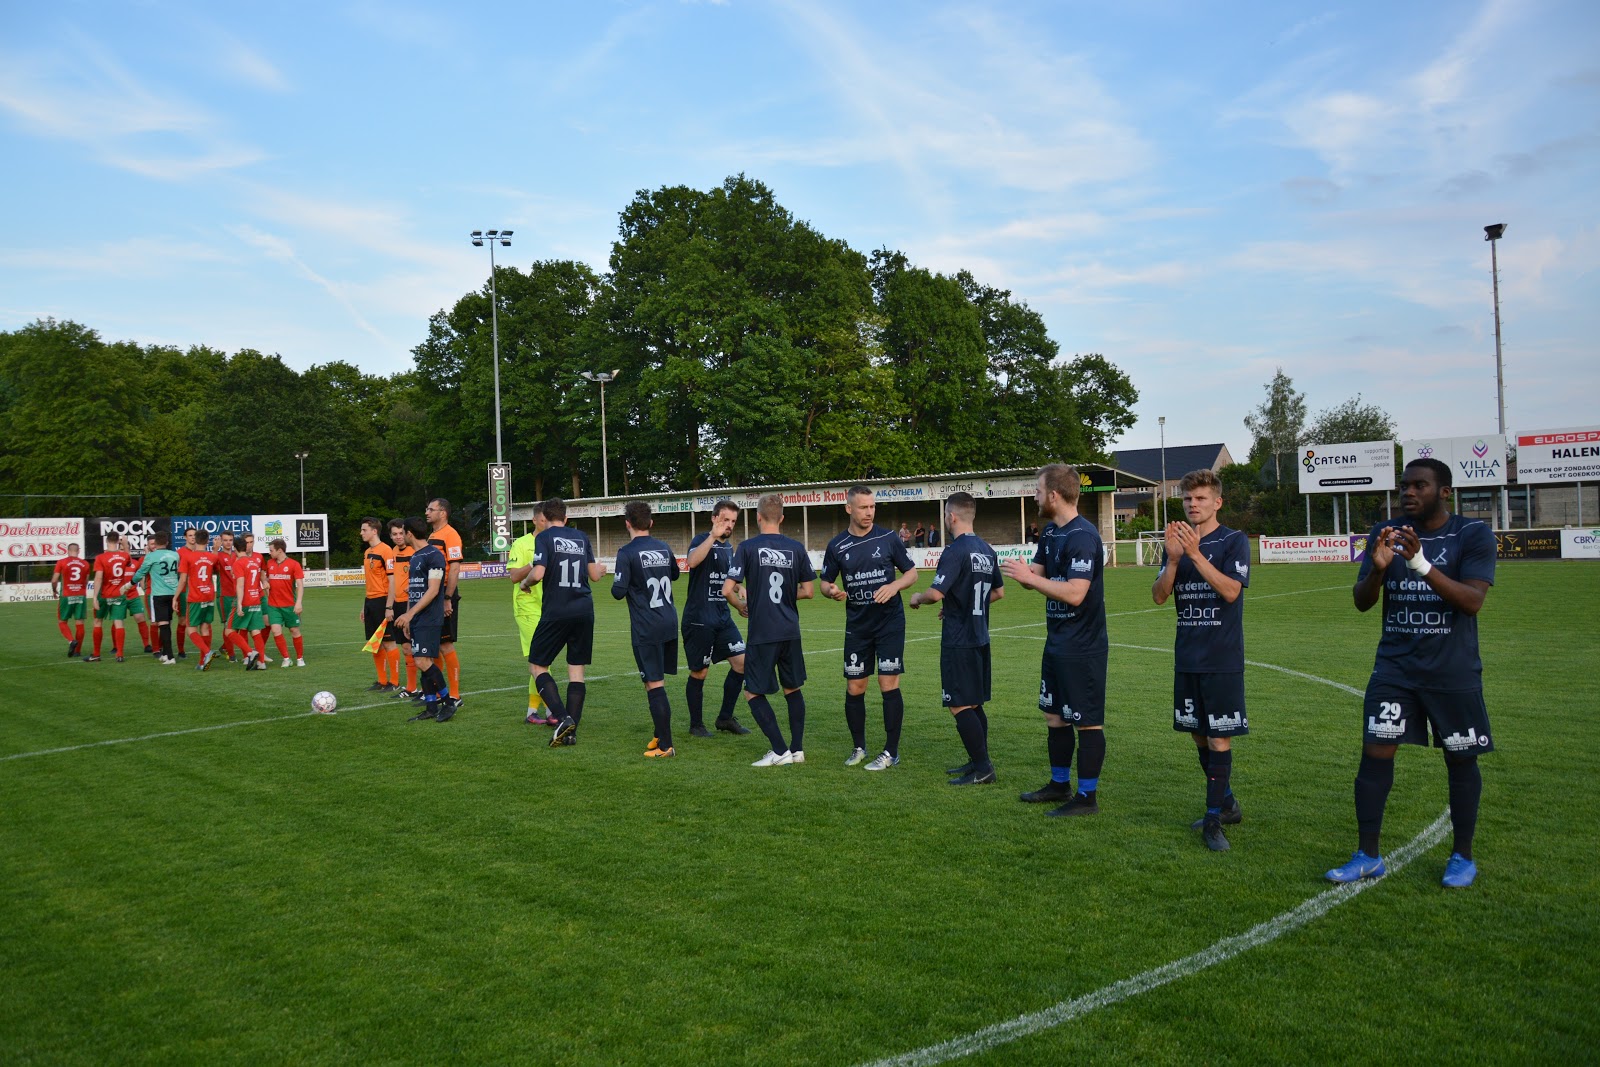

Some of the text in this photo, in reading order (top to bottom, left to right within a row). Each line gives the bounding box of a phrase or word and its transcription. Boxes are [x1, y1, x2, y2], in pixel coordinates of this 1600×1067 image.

[1552, 446, 1600, 458] HALEN
[1314, 455, 1357, 466] CATENA
[1459, 459, 1501, 469] VILLA
[1464, 468, 1496, 479] VITA
[777, 490, 821, 504] Rombouts
[876, 488, 923, 498] AIRCOTHERM
[658, 502, 679, 512] Kamiel
[680, 501, 694, 511] BEX
[100, 520, 156, 536] ROCK
[300, 530, 320, 538] NUTS
[9, 542, 67, 557] CARS
[1261, 538, 1348, 550] Traiteur Nico
[70, 566, 81, 582] 3
[112, 562, 124, 578] 6
[160, 560, 178, 576] 34
[197, 565, 208, 582] 4
[481, 566, 504, 574] KLUS
[559, 559, 581, 588] 11
[854, 569, 886, 581] dender
[250, 569, 258, 586] 7
[769, 571, 784, 604] 8
[850, 652, 858, 664] 9
[1184, 698, 1195, 713] 5
[1379, 701, 1402, 720] 29
